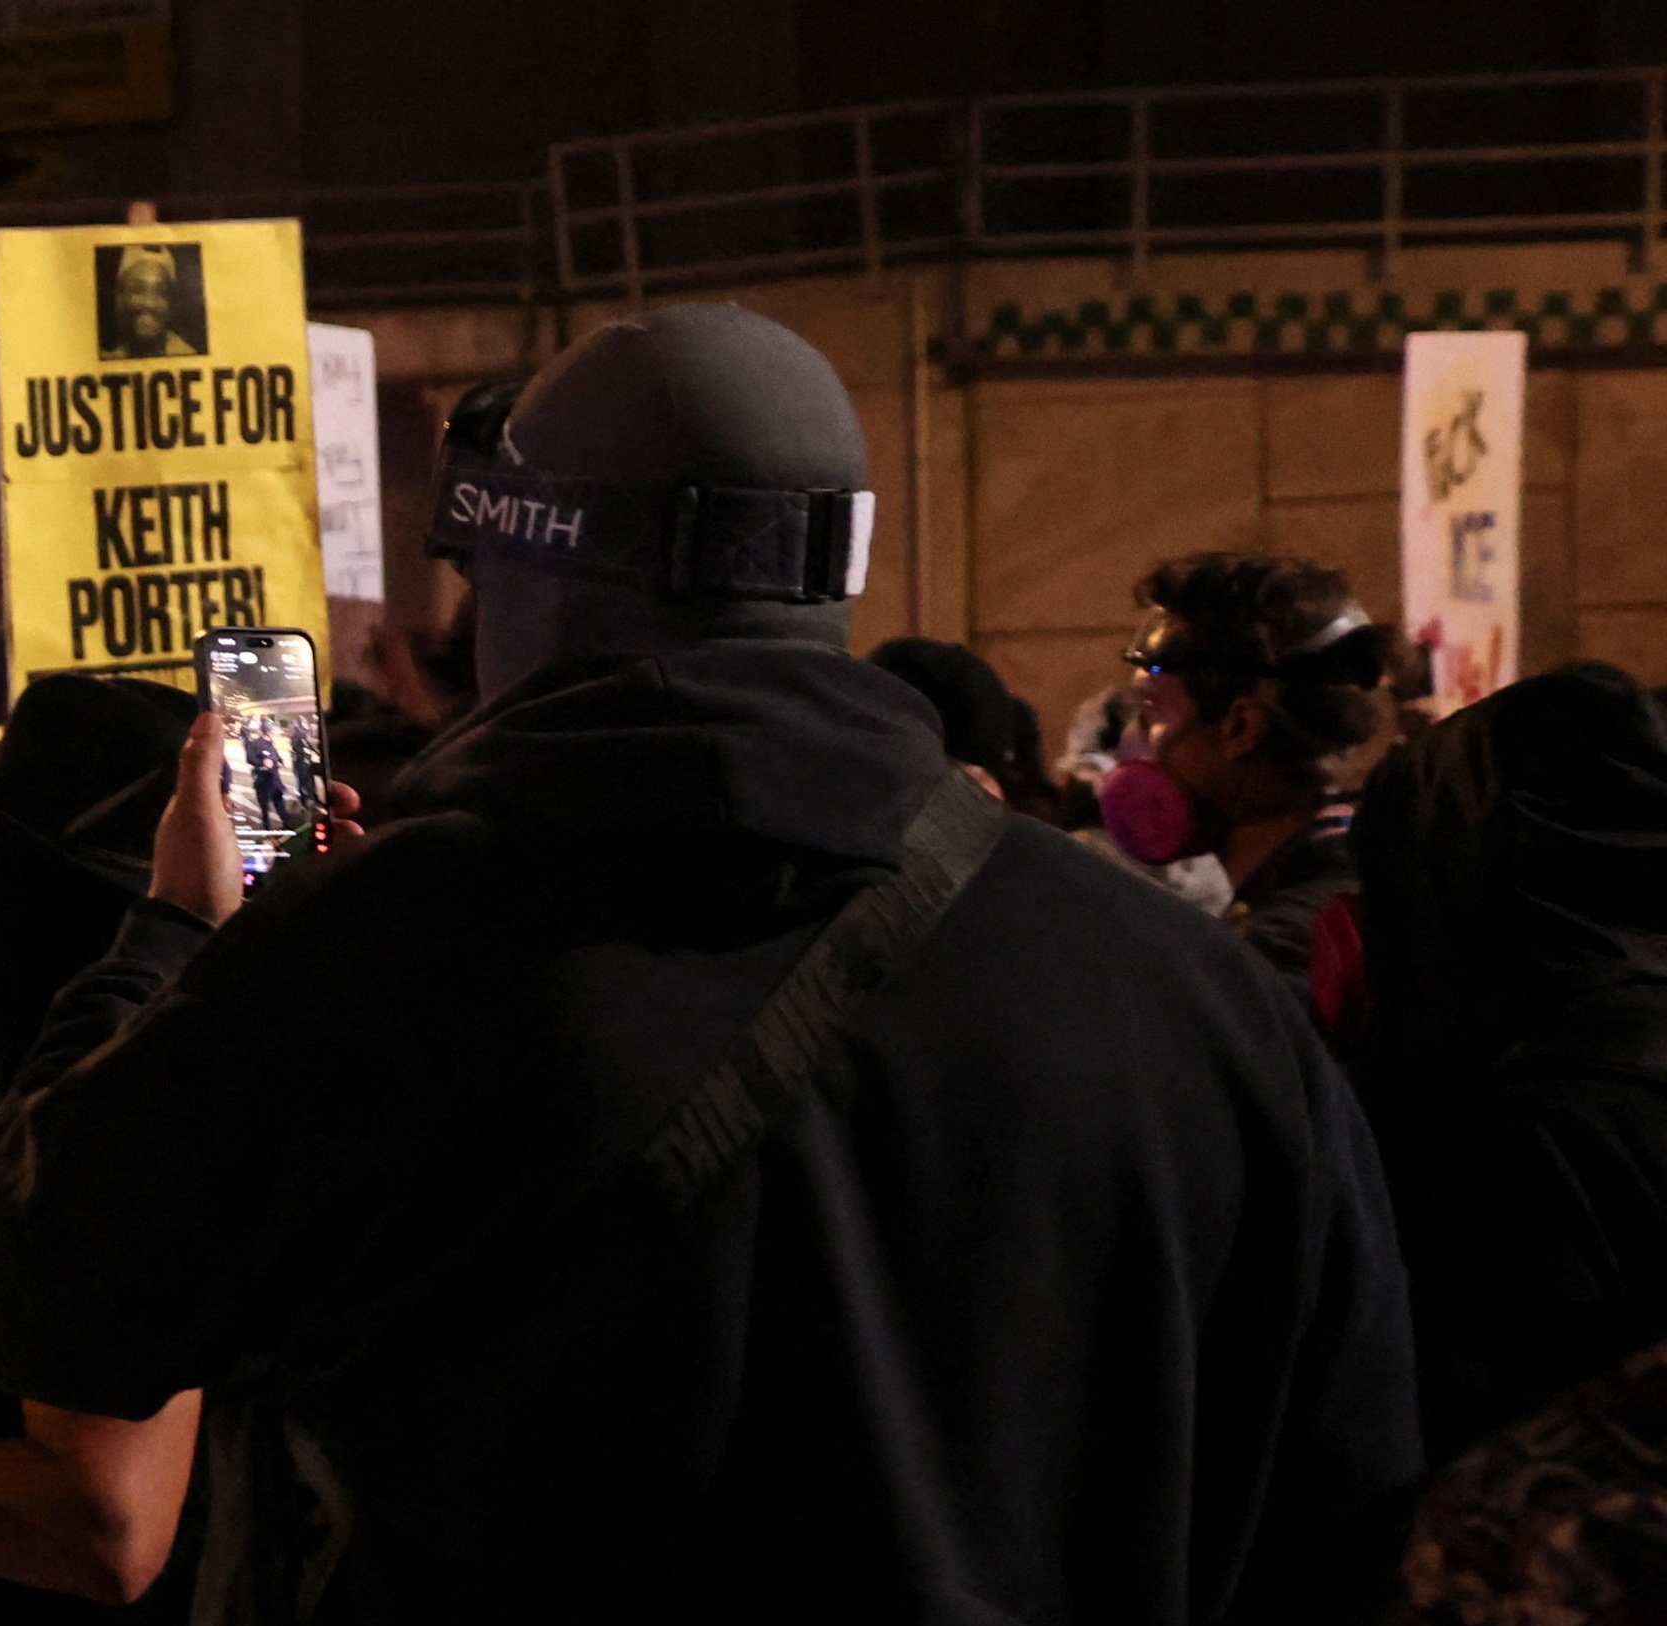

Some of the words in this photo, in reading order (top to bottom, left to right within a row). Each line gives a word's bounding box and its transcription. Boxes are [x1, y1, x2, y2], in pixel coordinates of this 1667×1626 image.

[16, 370, 205, 458] JUSTICE
[213, 365, 295, 445] FOR
[94, 482, 231, 569] KEITH
[450, 482, 584, 548] SMITH
